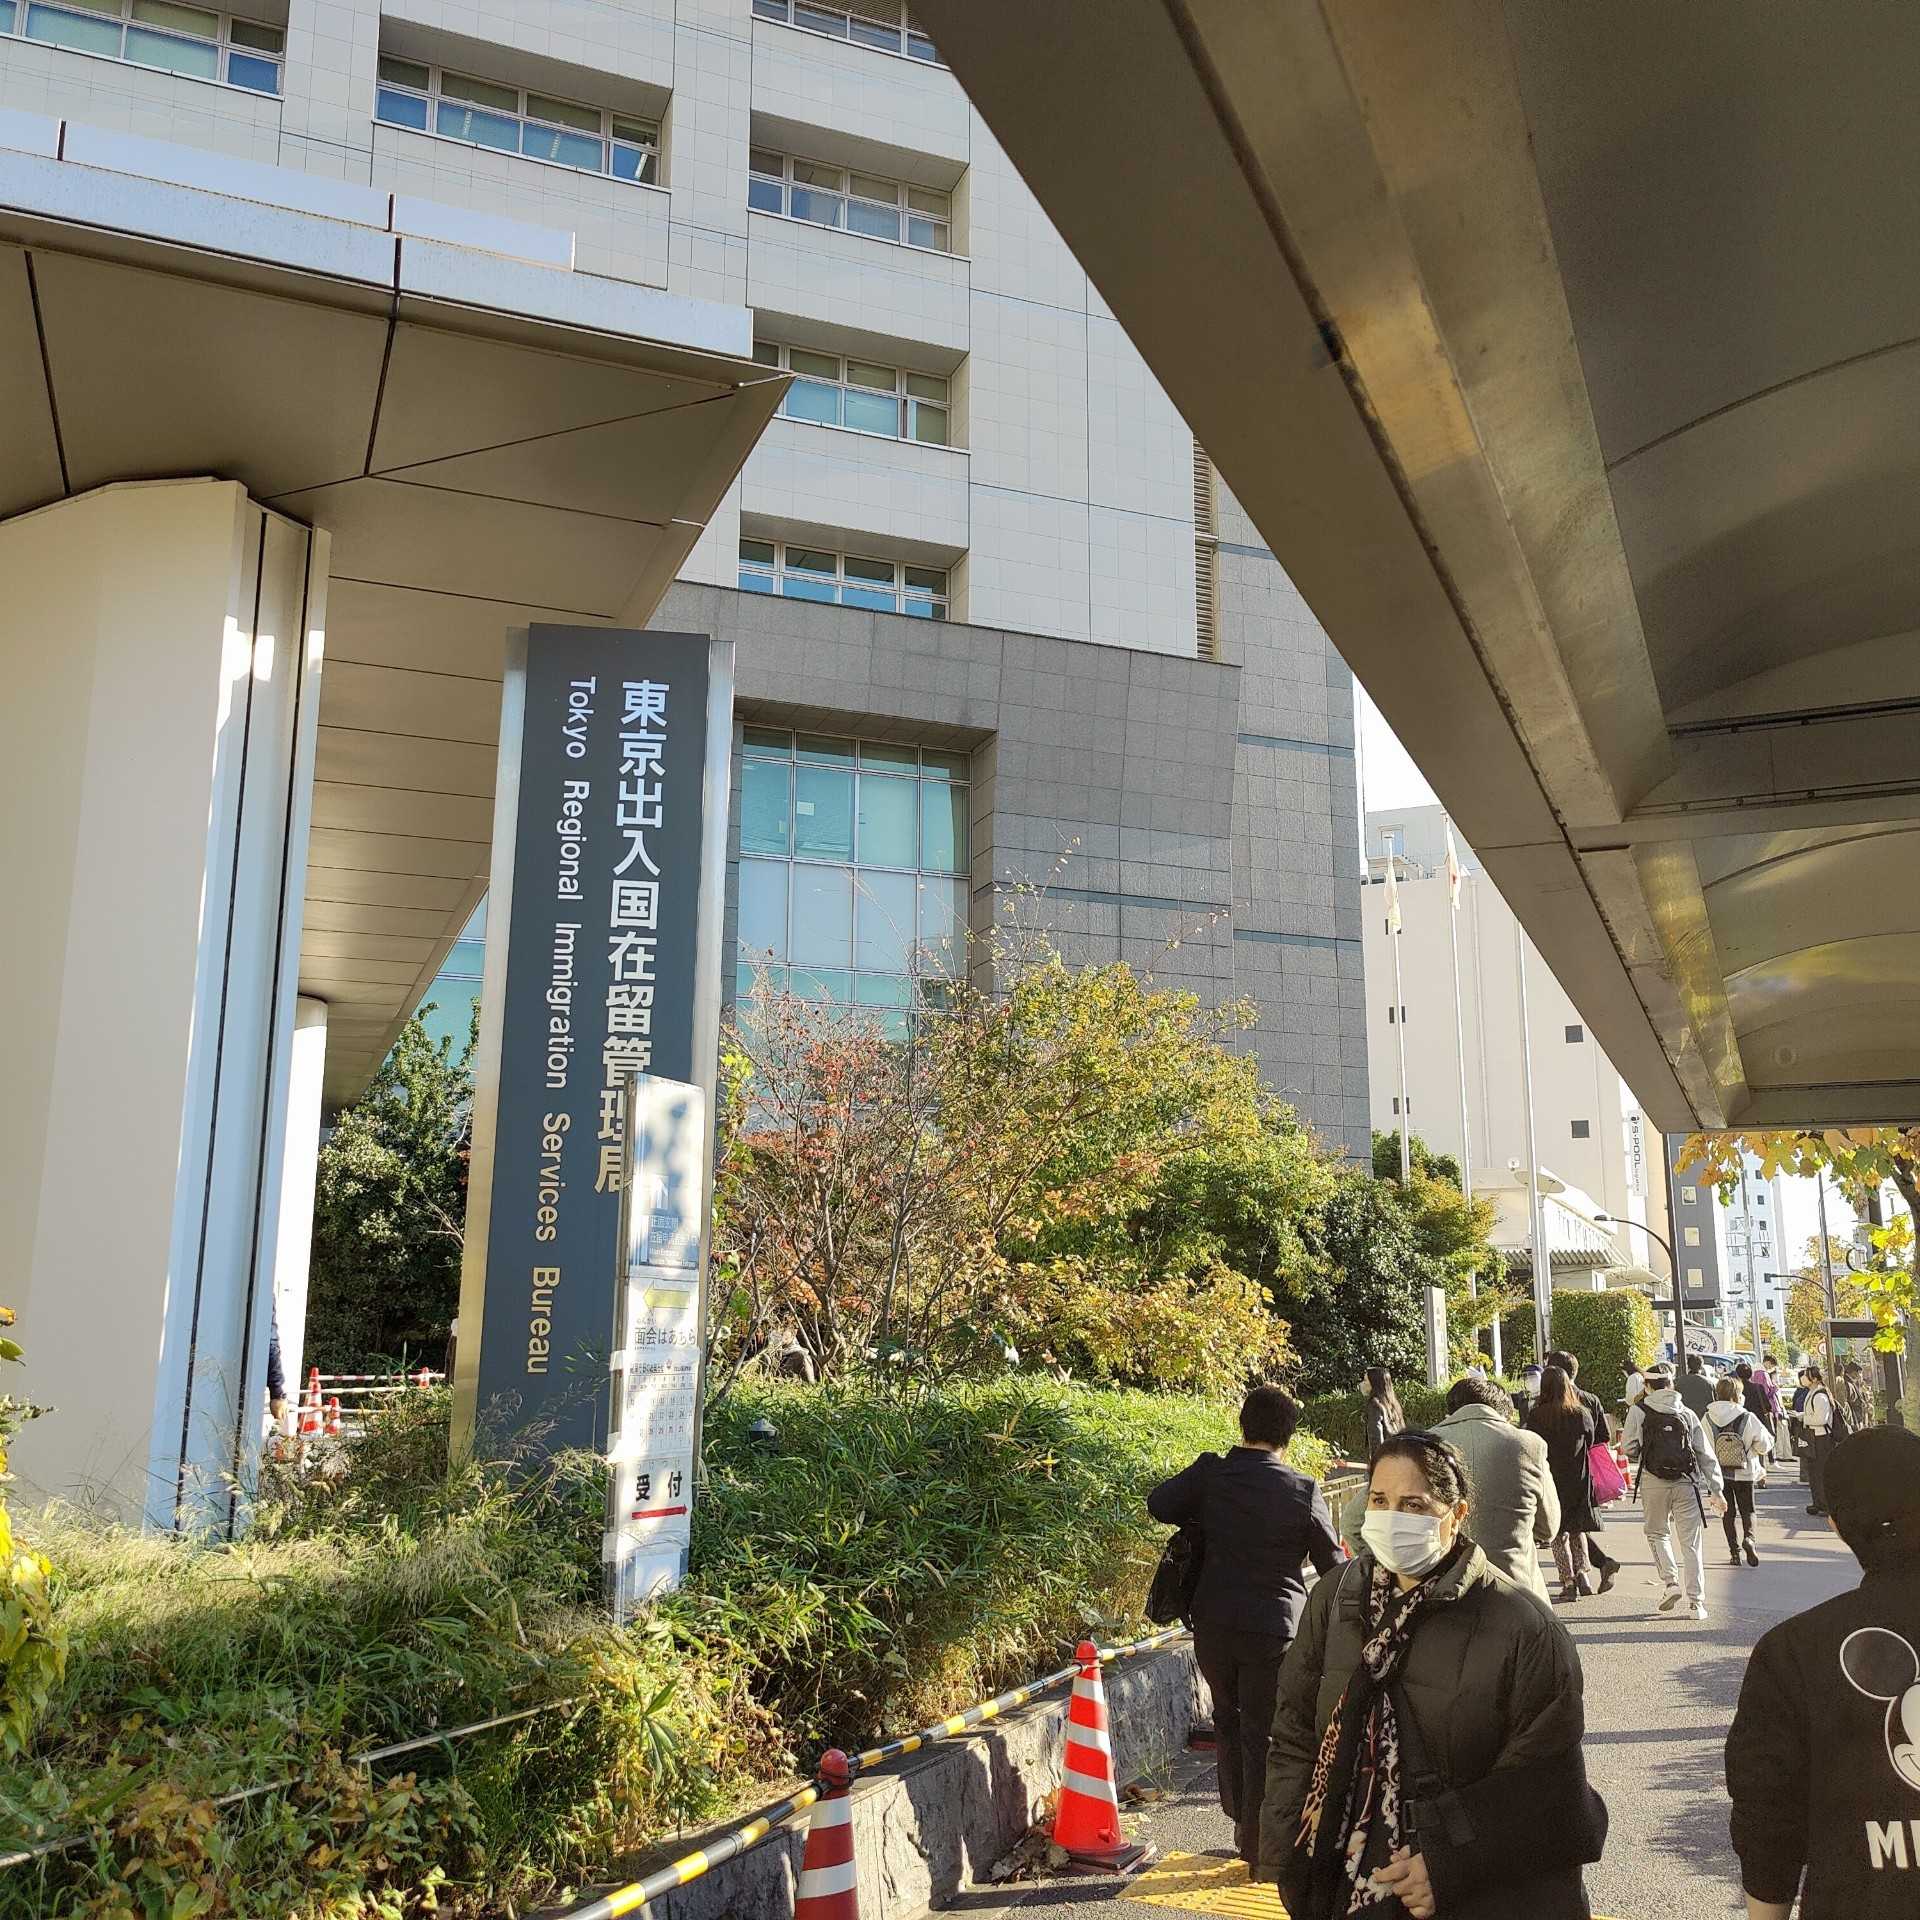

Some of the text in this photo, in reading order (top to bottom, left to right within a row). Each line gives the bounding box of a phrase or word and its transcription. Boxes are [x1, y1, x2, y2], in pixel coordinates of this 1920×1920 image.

[526, 676, 598, 1374] Tokyo Regional Immigration Services Bureau
[636, 1471, 682, 1500] 受付
